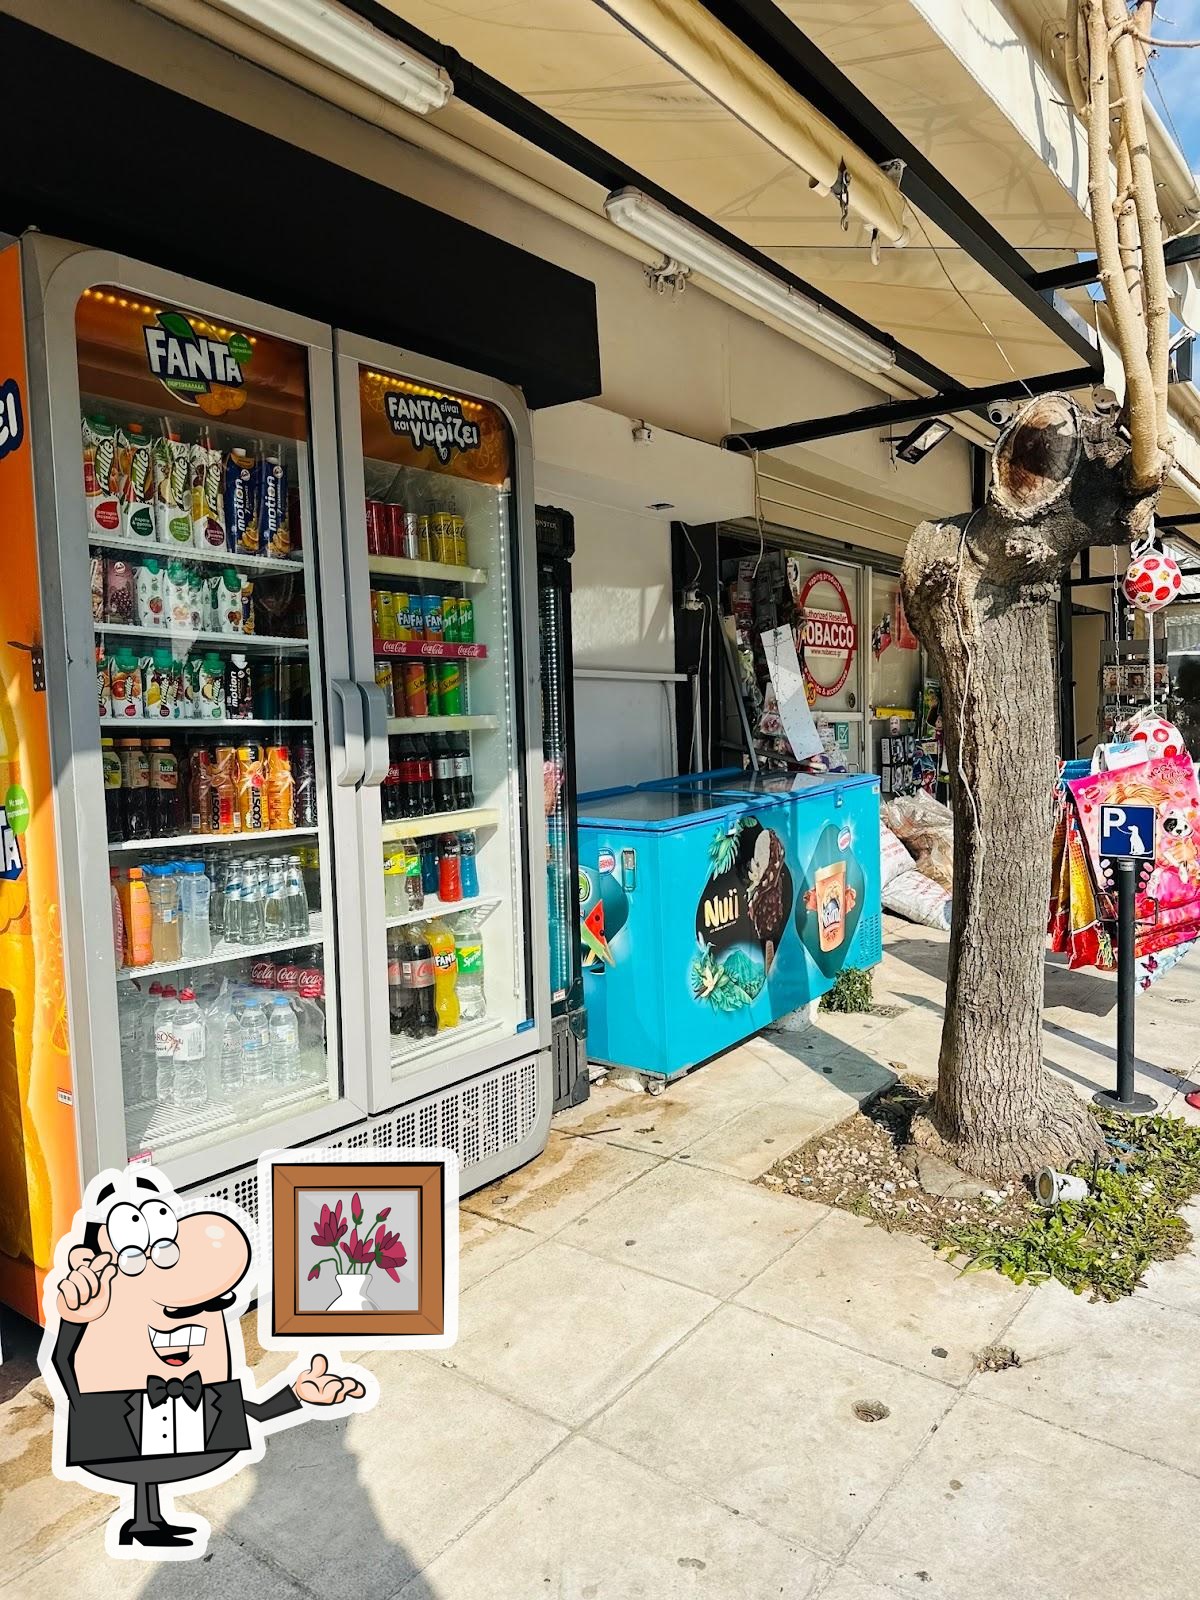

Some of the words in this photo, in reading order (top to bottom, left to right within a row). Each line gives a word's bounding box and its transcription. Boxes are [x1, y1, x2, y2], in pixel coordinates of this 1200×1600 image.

[145, 327, 243, 383] FANTA
[387, 396, 443, 422] FANTA
[440, 402, 459, 414] είναι
[393, 419, 410, 431] και
[409, 416, 478, 460] γυρίζει
[234, 478, 246, 531] motion
[265, 475, 277, 531] motion
[800, 621, 855, 649] OBACCO
[1103, 807, 1127, 837] P
[252, 962, 273, 979] Cola
[277, 967, 298, 983] Coca
